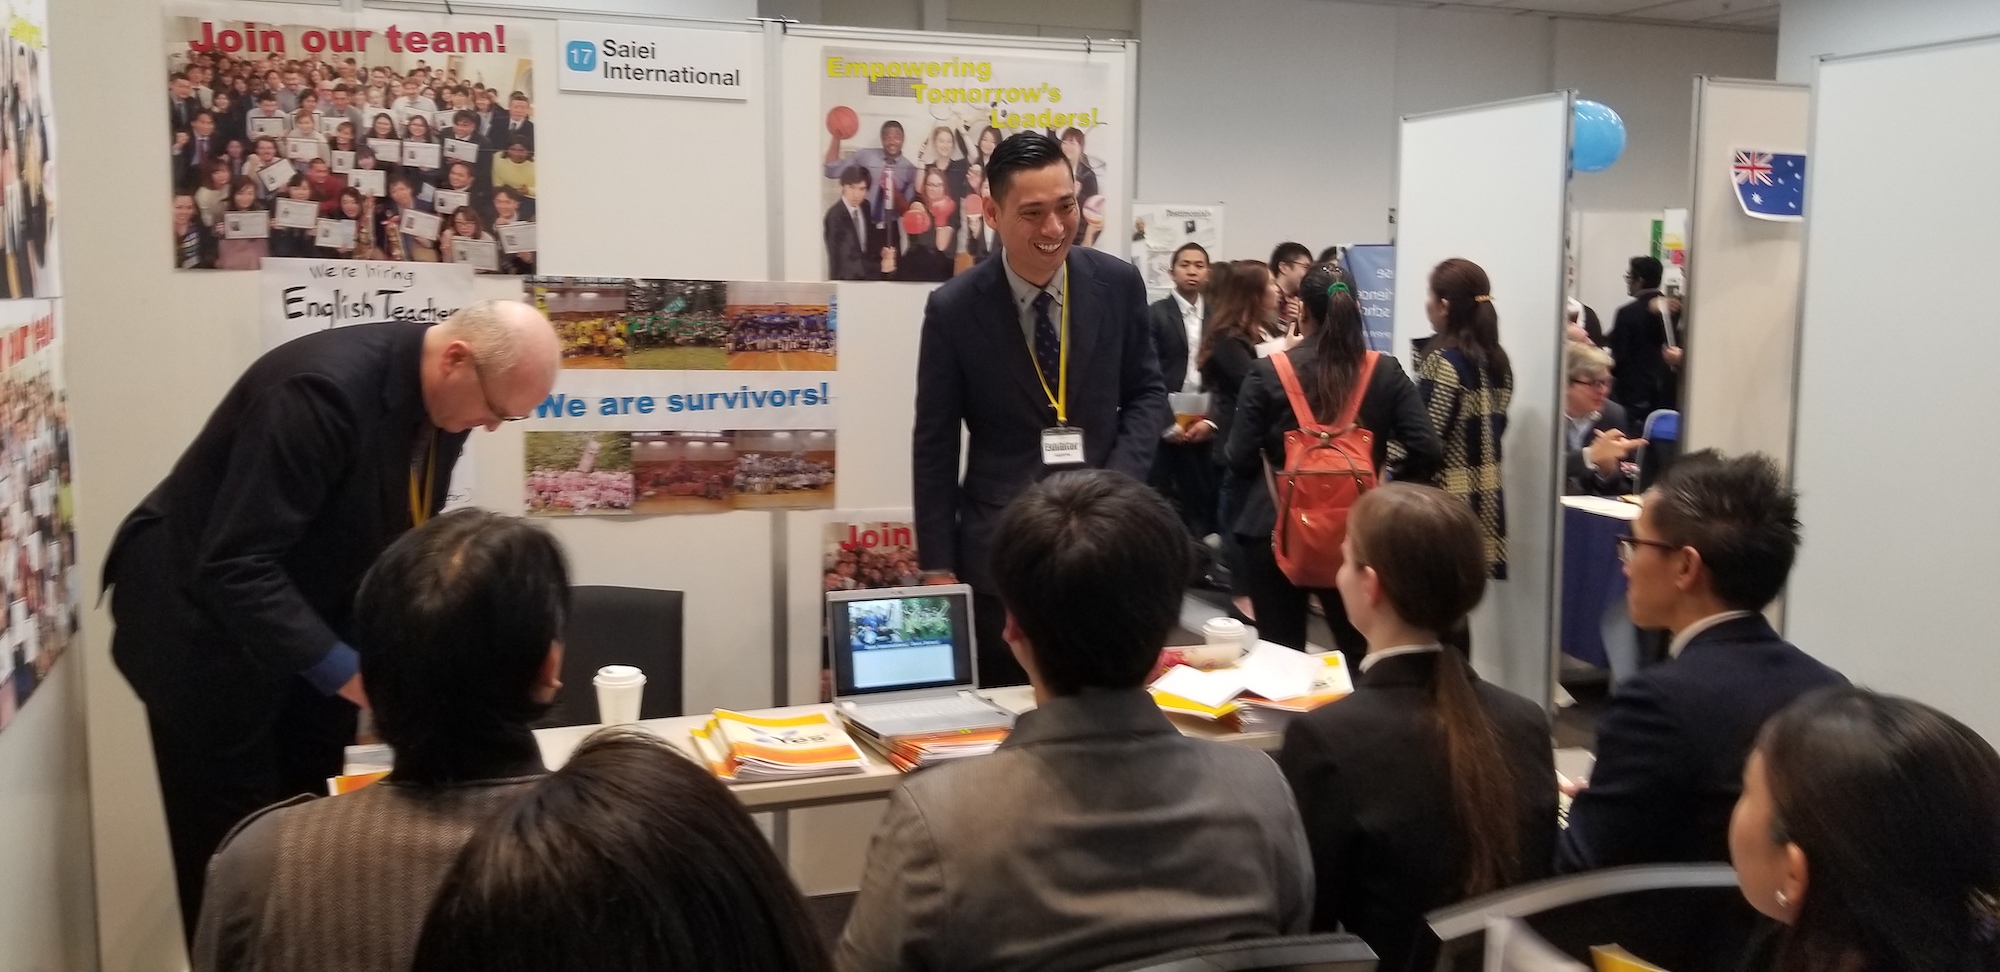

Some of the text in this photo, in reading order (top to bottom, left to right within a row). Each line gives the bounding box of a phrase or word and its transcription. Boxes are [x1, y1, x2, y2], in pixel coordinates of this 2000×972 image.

[189, 21, 507, 53] Join our team!
[602, 39, 655, 59] Saiei
[570, 48, 593, 65] 17
[603, 61, 741, 87] International
[826, 57, 992, 82] Empowering
[910, 83, 1062, 104] Tomorrow's
[991, 108, 1099, 129] Leaders!
[365, 264, 415, 287] hiring
[281, 286, 374, 328] English
[534, 382, 829, 418] We are survivors!
[839, 523, 911, 550] Join
